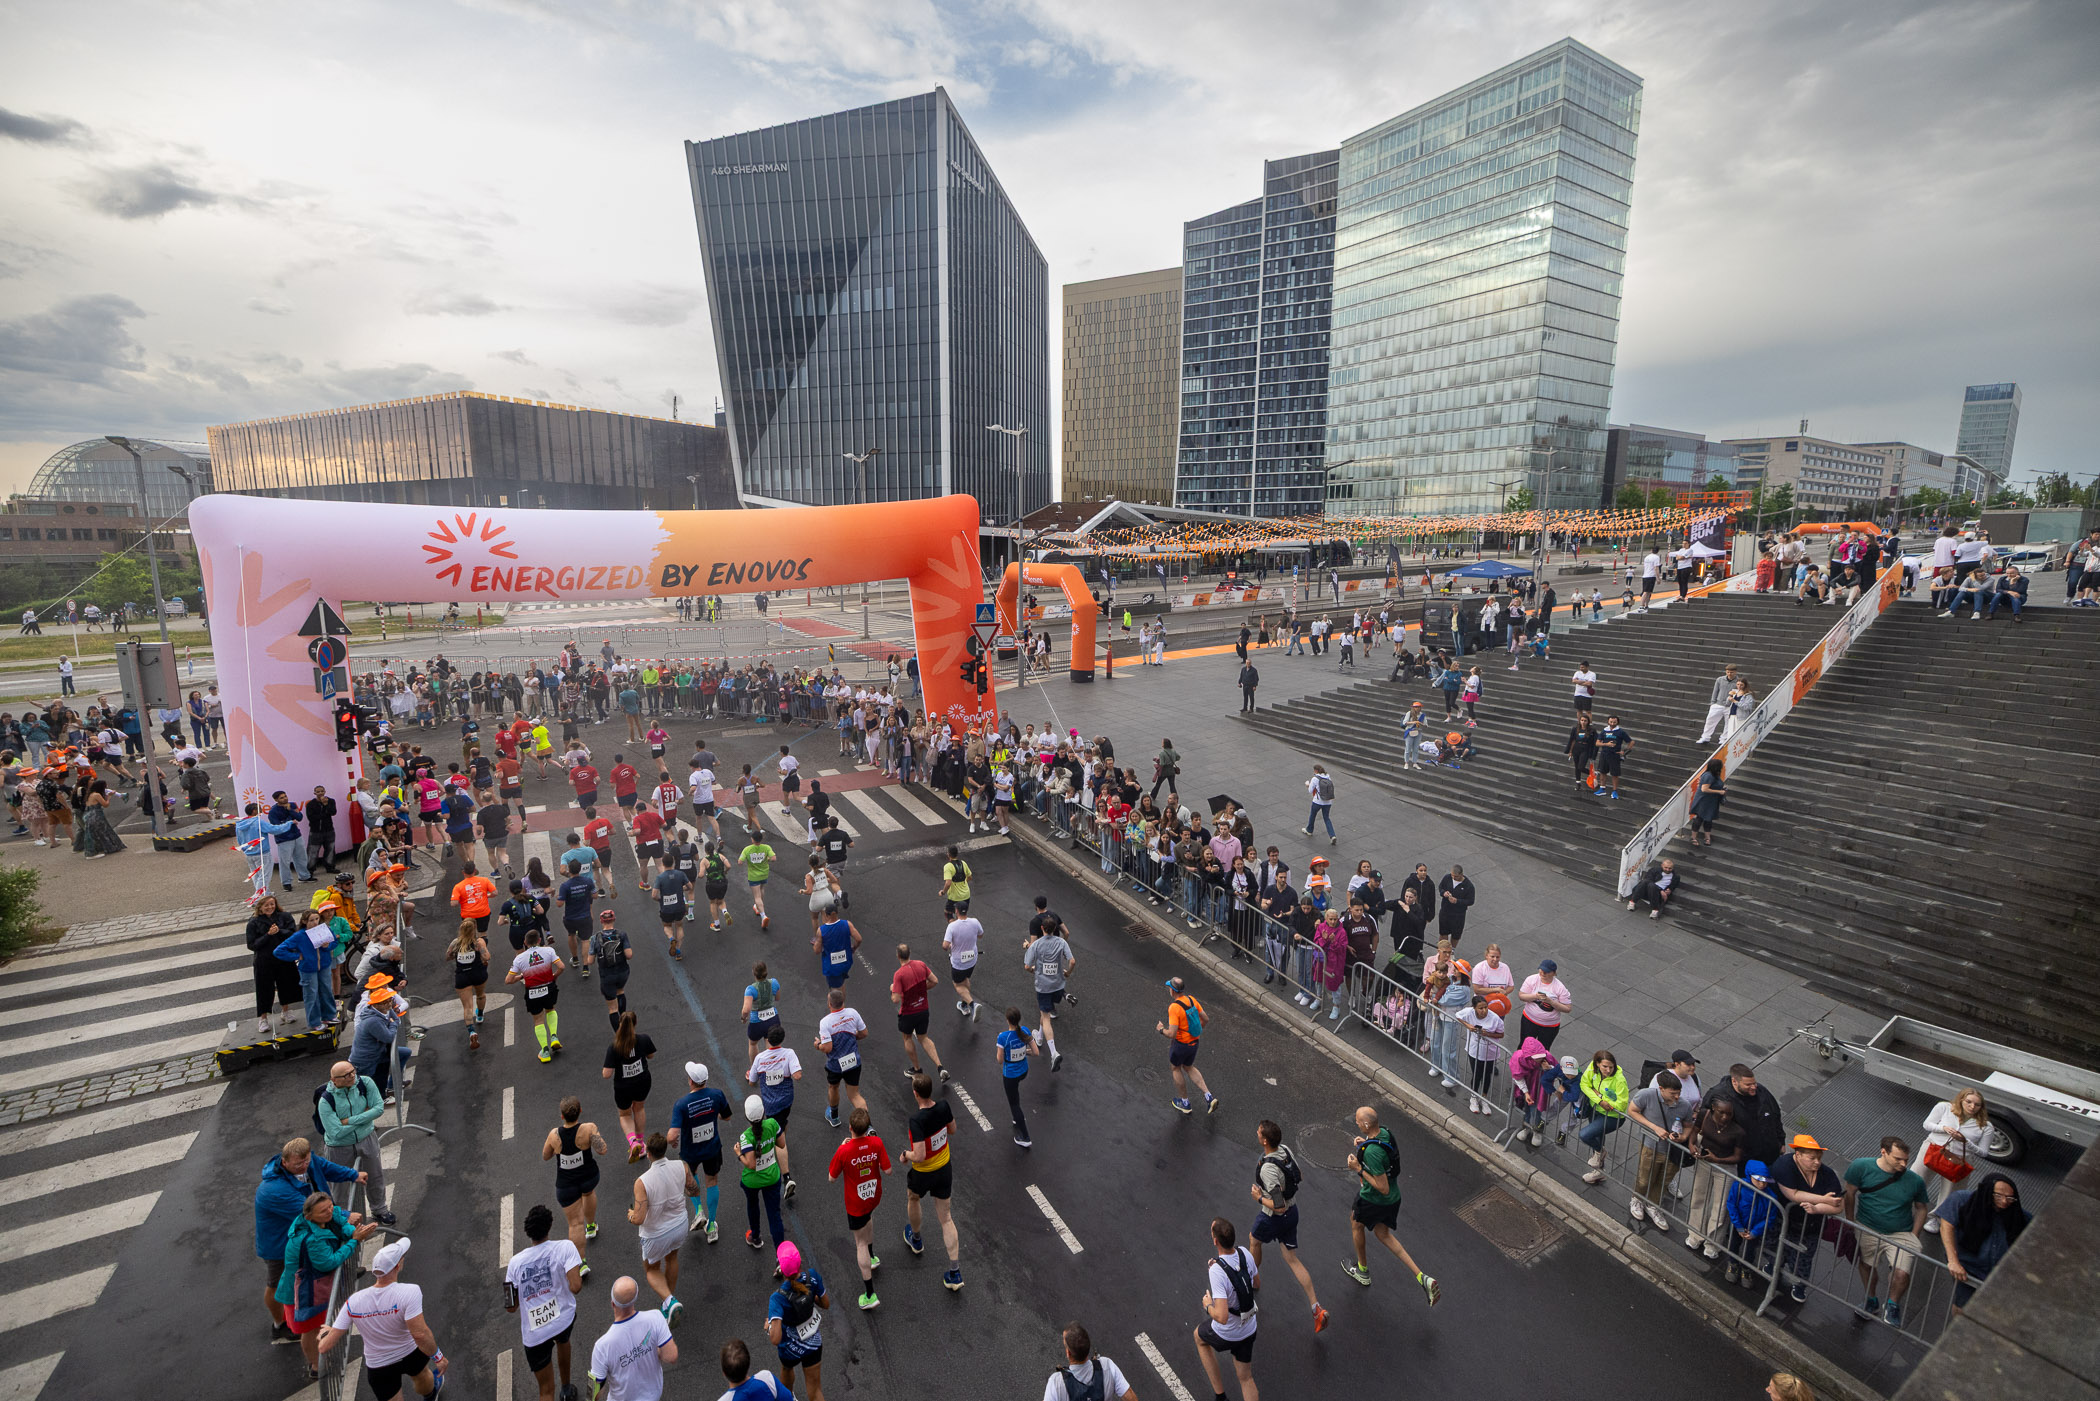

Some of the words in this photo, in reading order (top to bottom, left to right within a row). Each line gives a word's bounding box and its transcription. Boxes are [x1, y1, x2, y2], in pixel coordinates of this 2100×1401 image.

[711, 166, 732, 176] A&O
[733, 163, 788, 175] SHEARMAN
[1691, 515, 1726, 534] BETTY
[1690, 526, 1714, 542] RUN
[470, 565, 644, 598] ENERGIZED
[660, 564, 699, 588] BY
[707, 558, 813, 586] ENOVOS
[663, 791, 675, 803] 31
[624, 1062, 641, 1071] TEAM
[840, 1060, 848, 1068] 21
[848, 1056, 857, 1065] KM
[626, 1068, 641, 1077] RUN
[693, 1131, 702, 1139] 21
[703, 1127, 714, 1136] KM
[570, 1156, 582, 1165] KM
[858, 1181, 877, 1193] TEAM
[861, 1190, 875, 1200] RUN
[530, 1299, 557, 1318] TEAM
[535, 1310, 556, 1327] RUN
[799, 1325, 808, 1337] 21
[809, 1313, 821, 1329] KM
[619, 1344, 644, 1363] PURE
[620, 1347, 652, 1368] CAPITAL
